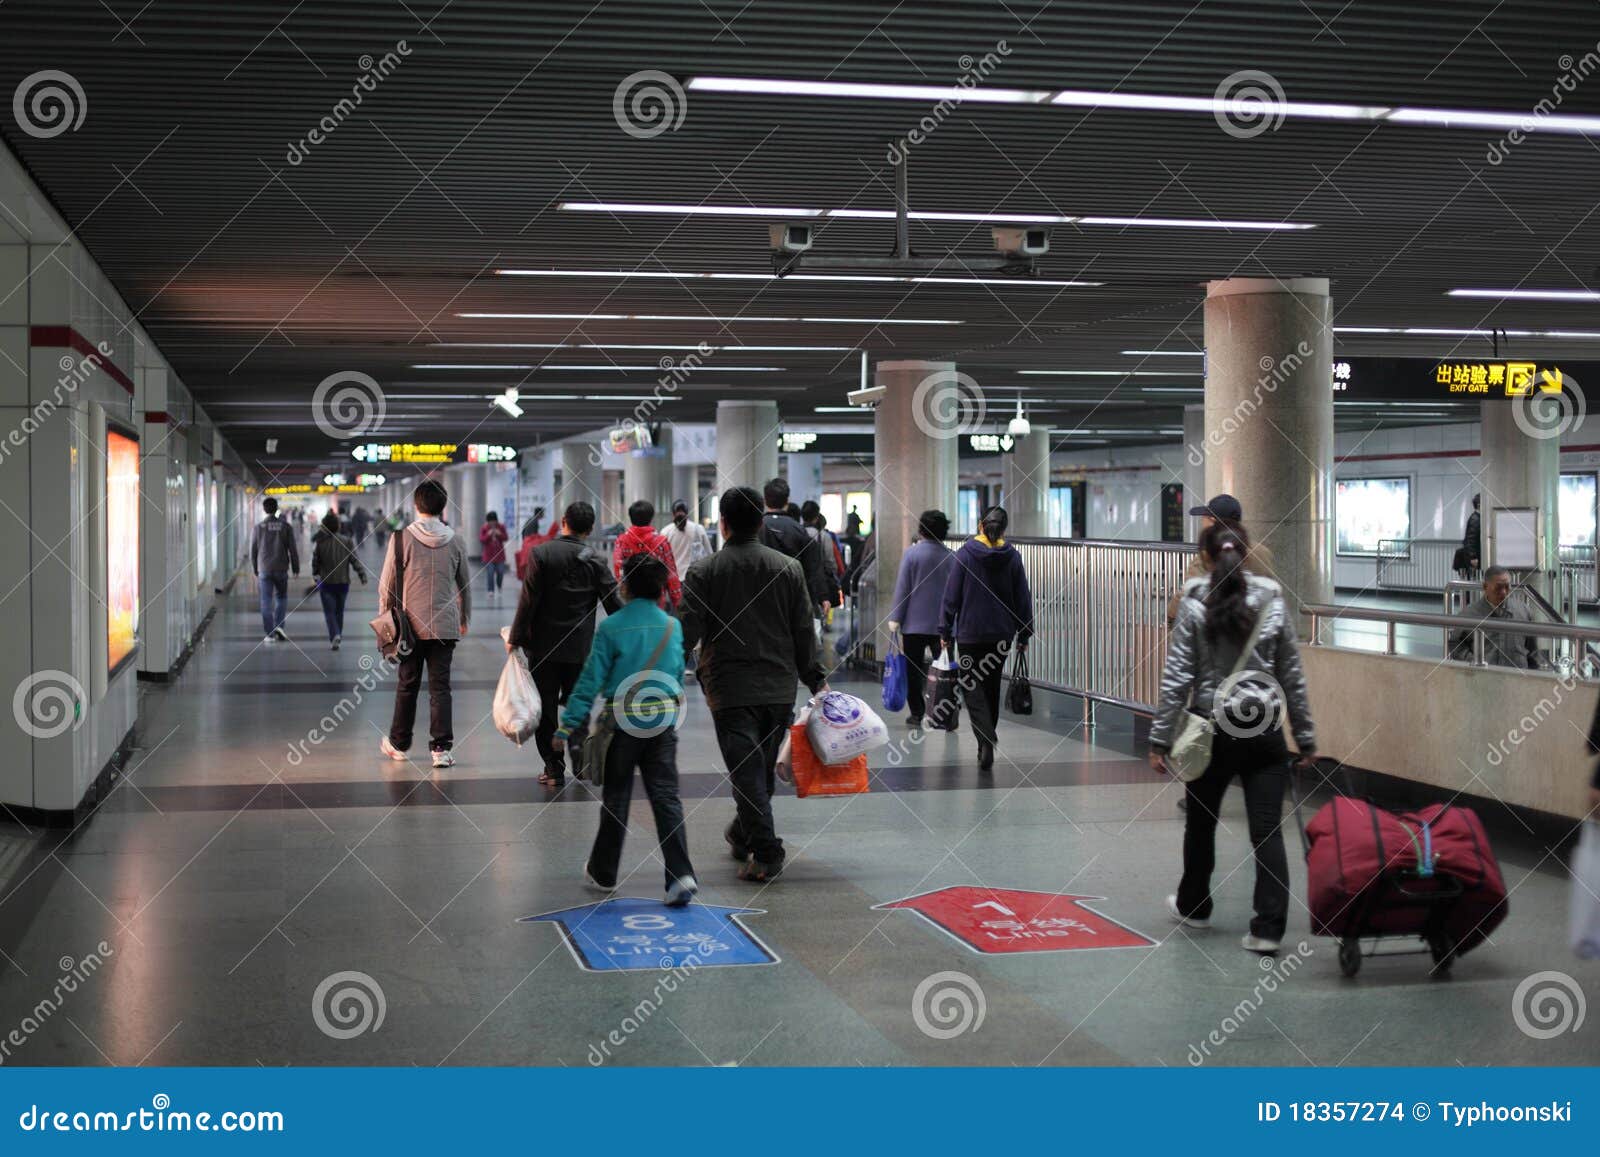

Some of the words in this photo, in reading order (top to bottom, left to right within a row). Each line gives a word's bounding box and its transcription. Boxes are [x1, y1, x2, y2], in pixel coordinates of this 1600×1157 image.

[1436, 364, 1506, 385] 出站验票
[1450, 384, 1468, 392] EXIT
[1468, 384, 1489, 393] GATE
[622, 914, 675, 930] 8
